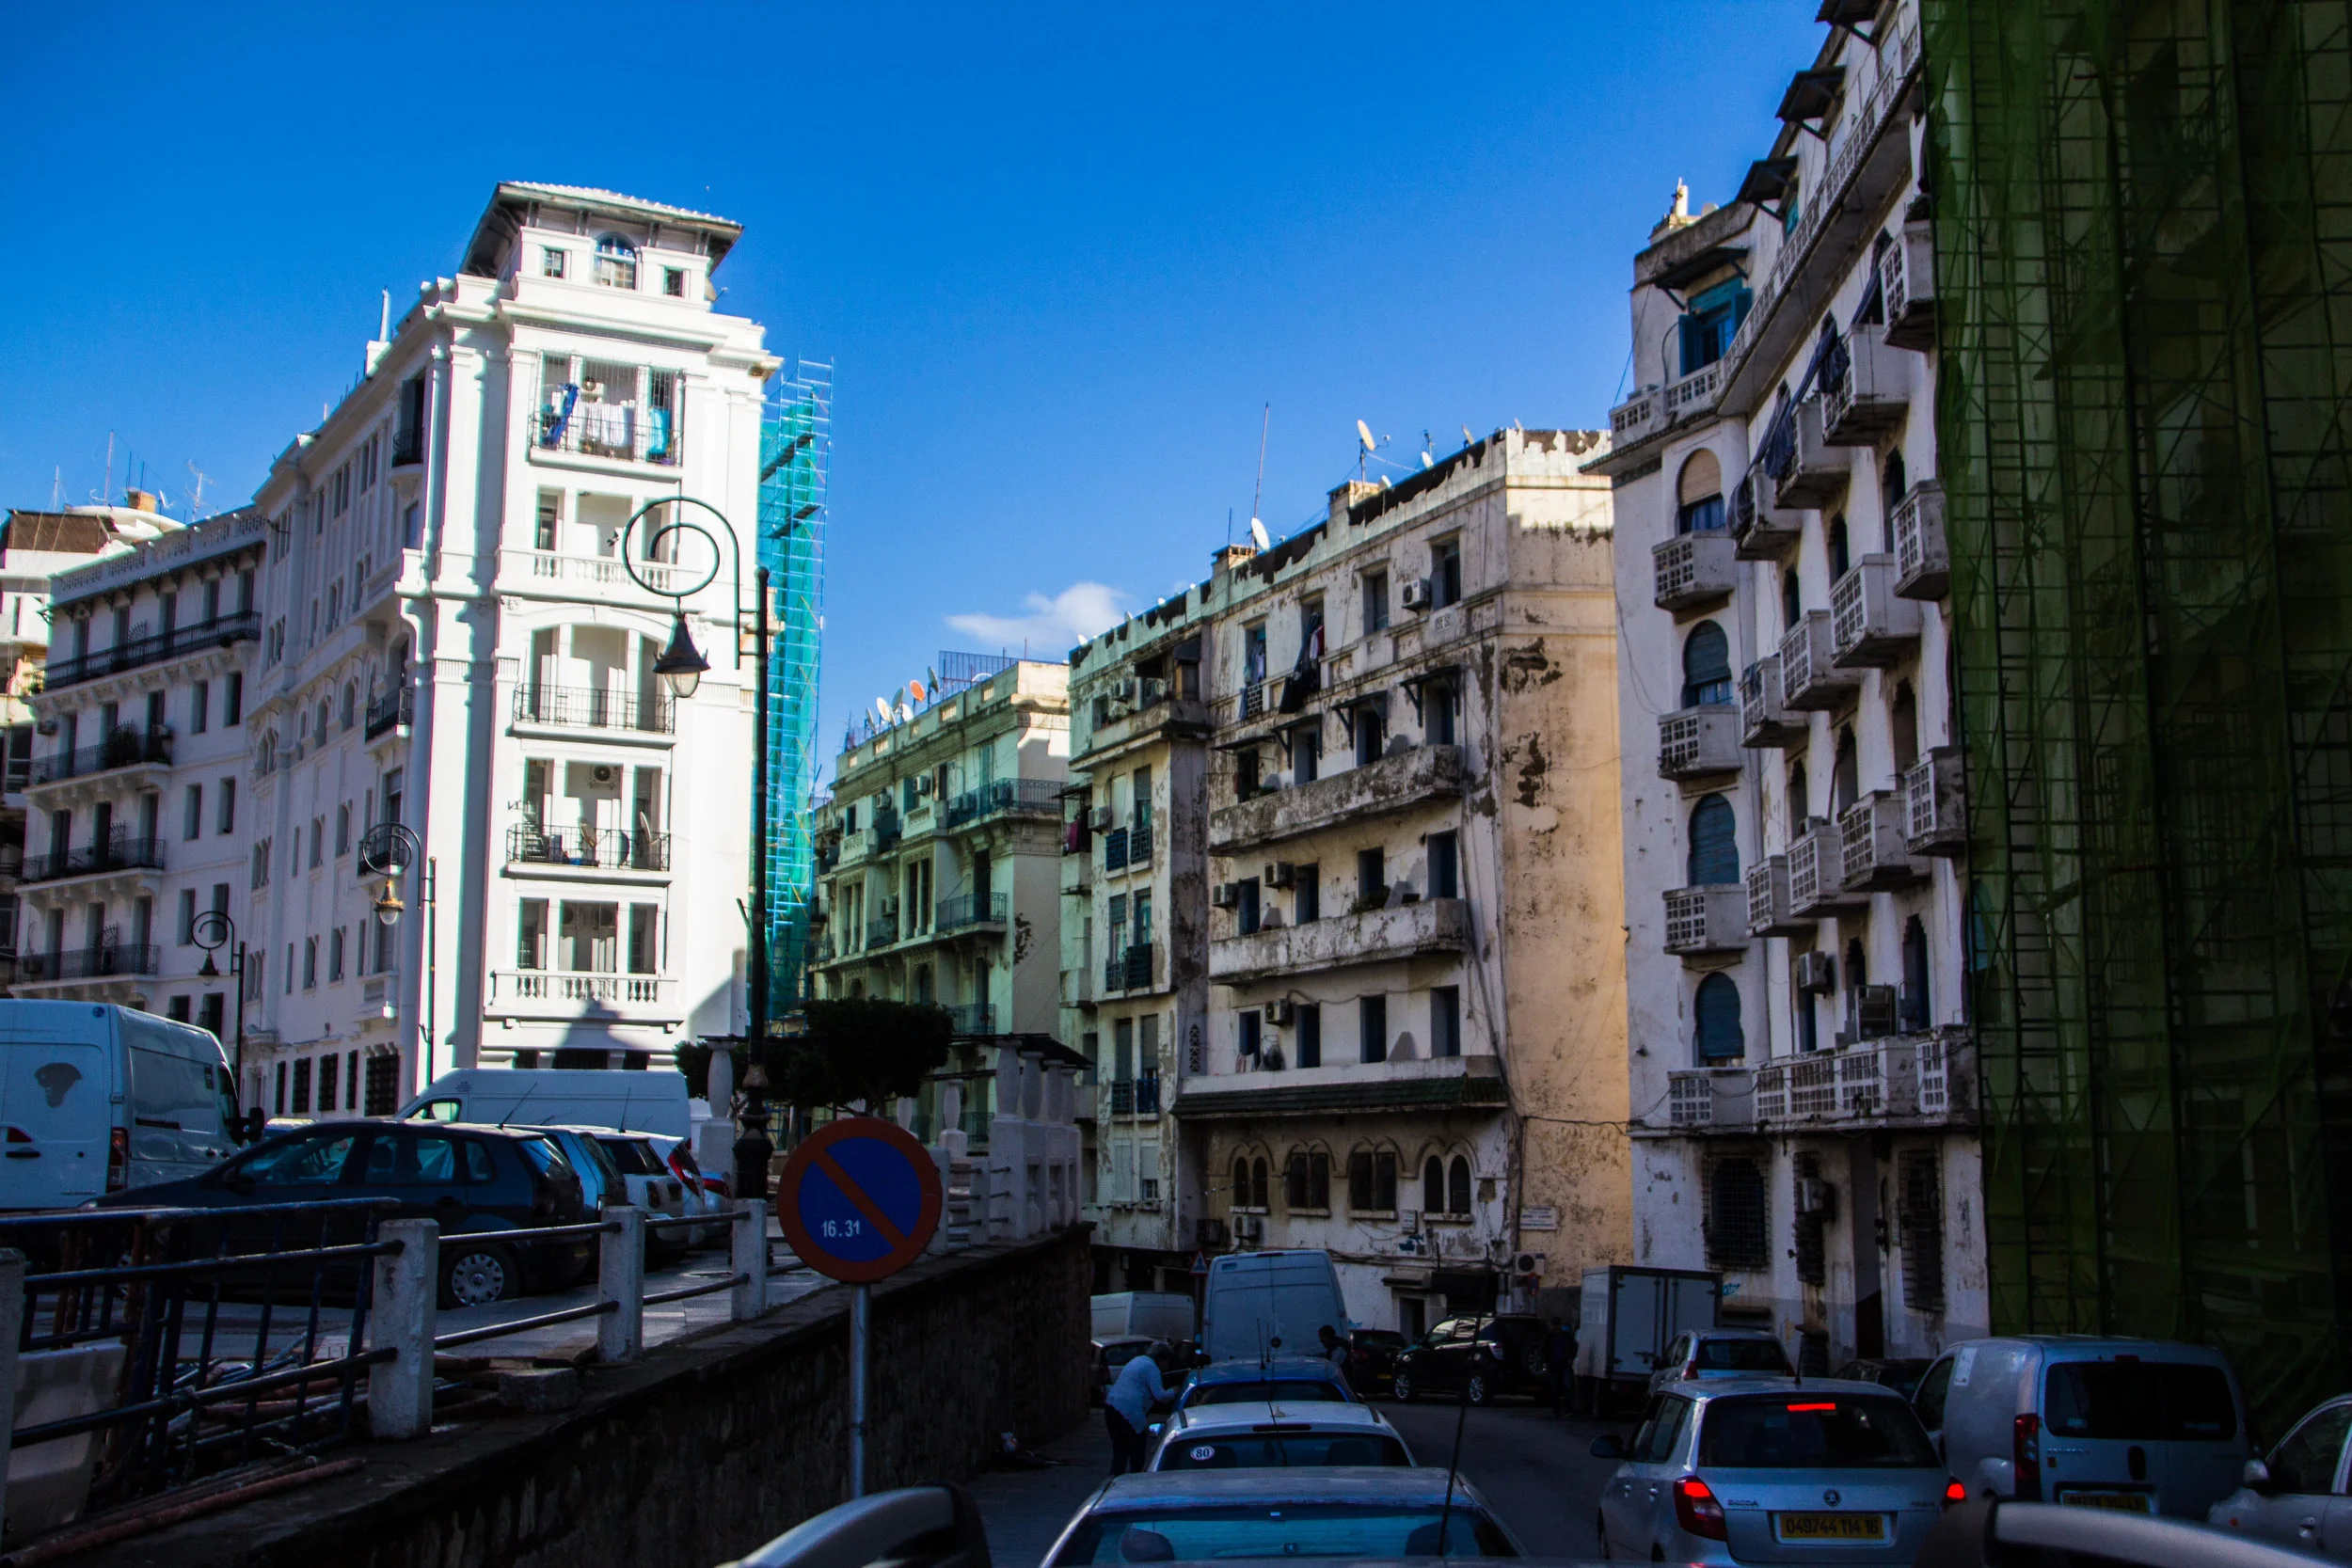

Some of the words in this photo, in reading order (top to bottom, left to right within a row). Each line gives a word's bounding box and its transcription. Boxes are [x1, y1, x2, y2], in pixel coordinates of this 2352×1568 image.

[820, 1219, 861, 1238] 16.31
[1196, 1448, 1211, 1458] 80
[1786, 1517, 1837, 1534] 049744
[1865, 1518, 1880, 1534] 16
